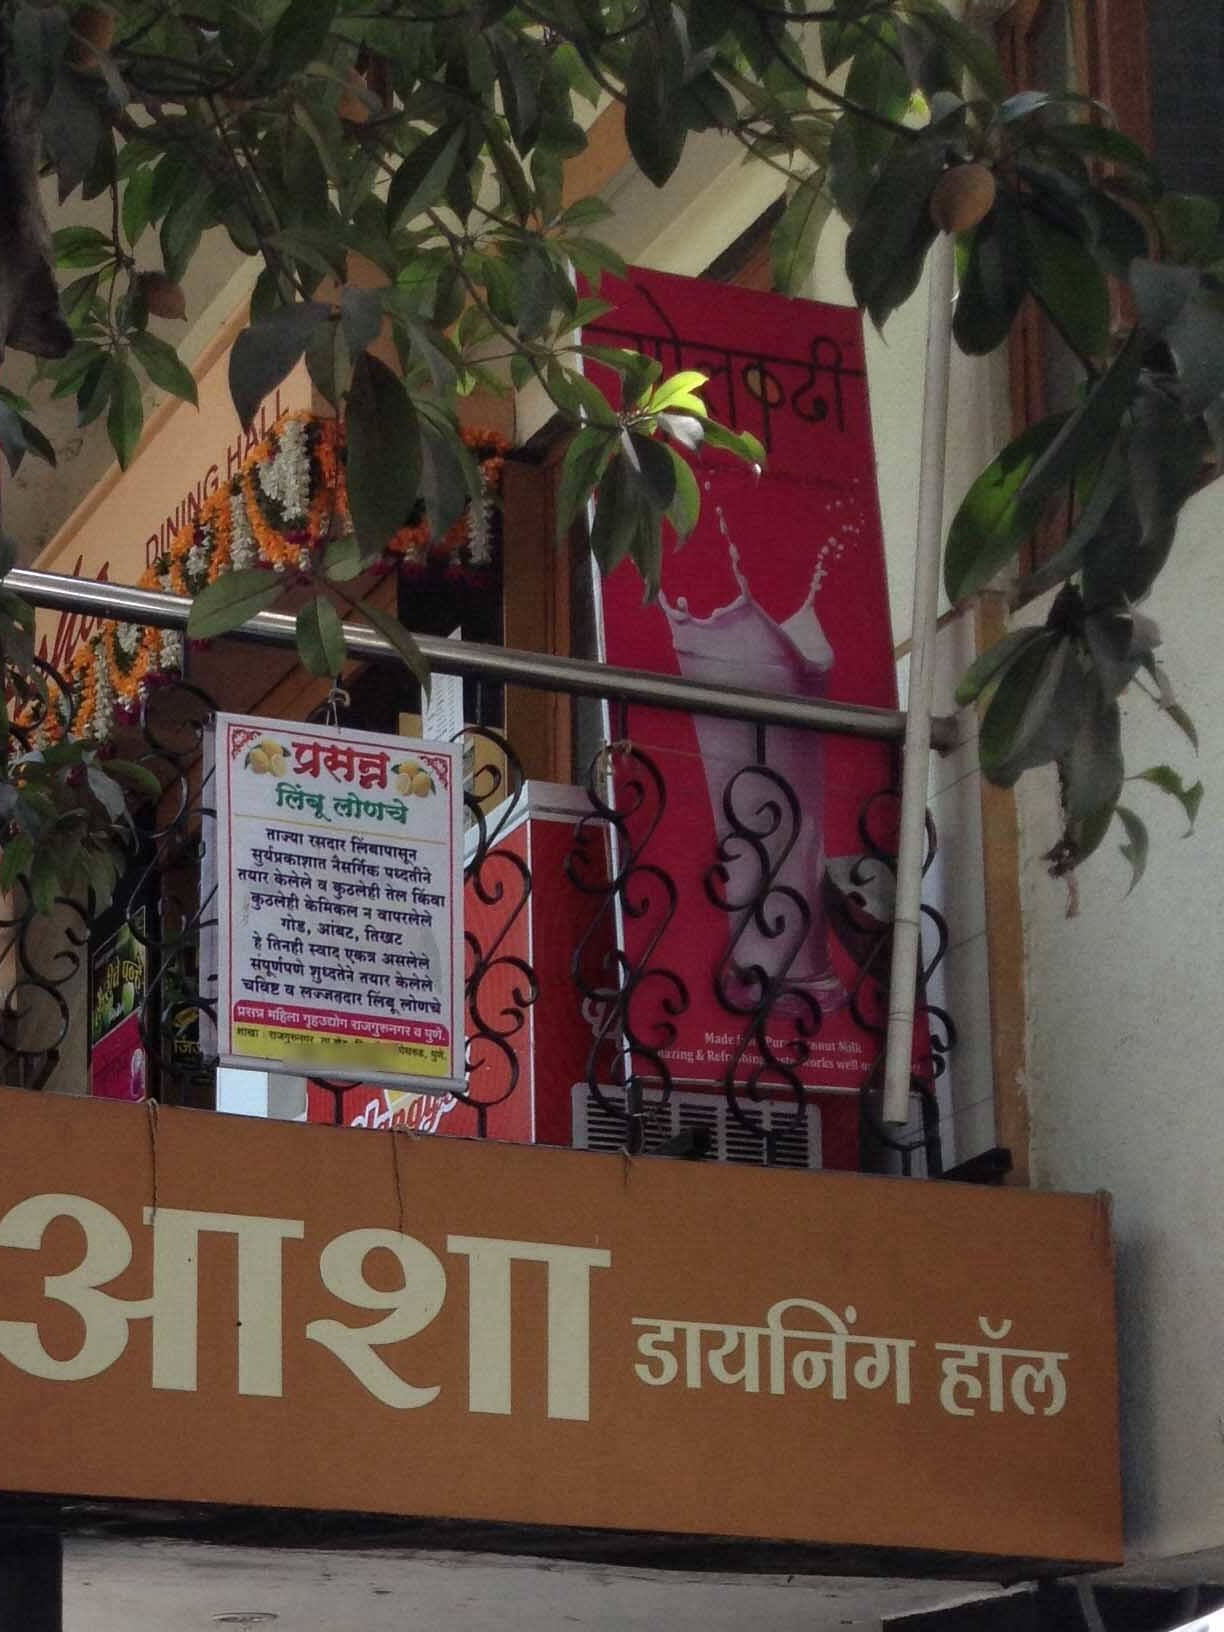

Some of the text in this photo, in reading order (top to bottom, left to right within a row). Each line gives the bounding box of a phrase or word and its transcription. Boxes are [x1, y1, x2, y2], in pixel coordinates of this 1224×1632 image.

[291, 741, 391, 789] प्रसन्न
[276, 782, 409, 824] लिंबू लोणचे
[266, 828, 417, 866] ताज्या रसदार लिंबापासून
[332, 855, 379, 876] नैसर्गिक
[237, 867, 446, 908] तयार केलेले व कुठलेही तेल किंवा
[250, 890, 432, 927] कुठलेही केमिकल न वापरलेले
[281, 914, 403, 945] गोड, आंबट, तिखट
[252, 931, 430, 971] हे तिनही स्वाद एकत्र असलेले
[241, 976, 442, 1014] चविष्ट व लज्जतदार लिंबू लोणचे
[359, 972, 391, 988] तयार
[395, 971, 432, 992] केलेले
[268, 1007, 300, 1024] महिला
[704, 1032, 734, 1045] Made
[632, 1298, 914, 1403] डायनिंग
[935, 1316, 1070, 1420] हॉल
